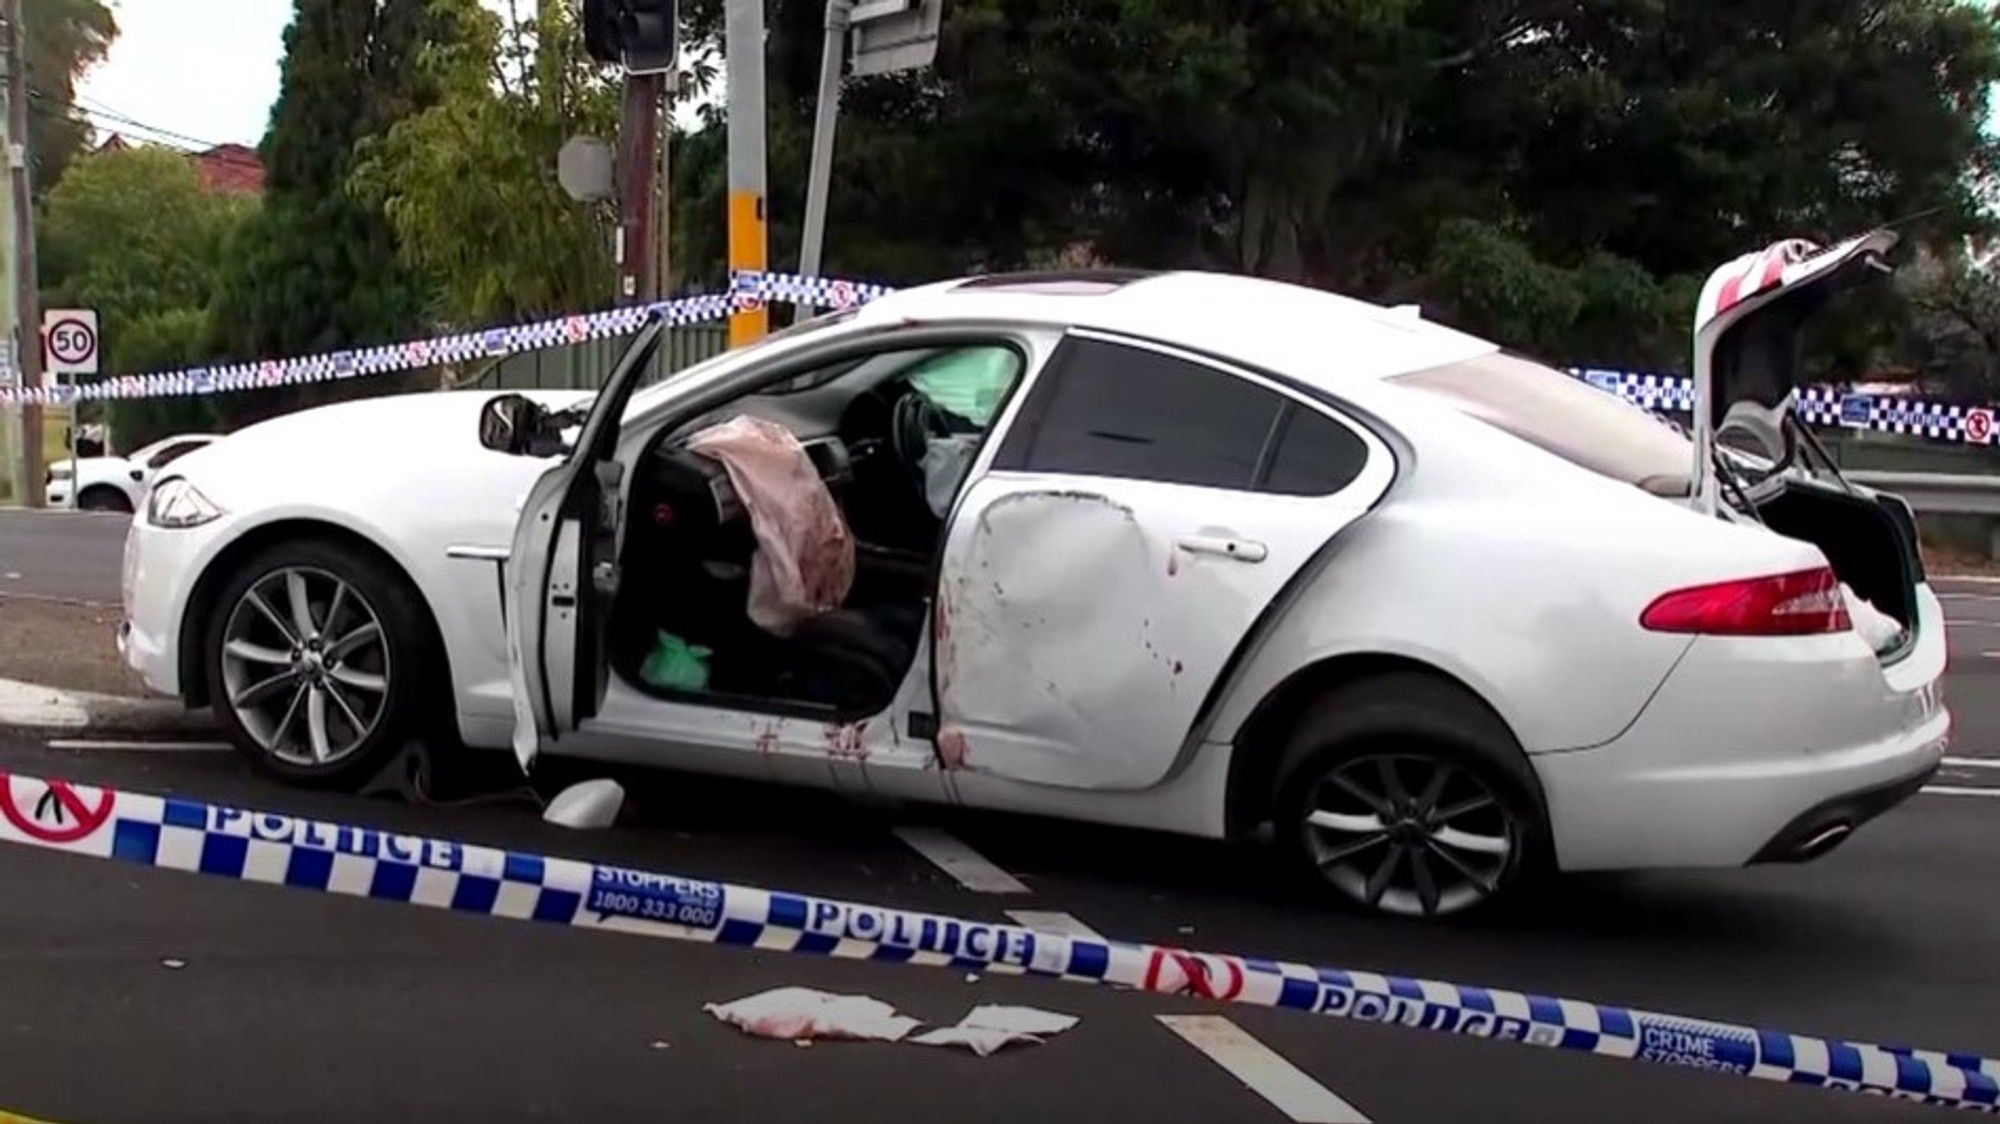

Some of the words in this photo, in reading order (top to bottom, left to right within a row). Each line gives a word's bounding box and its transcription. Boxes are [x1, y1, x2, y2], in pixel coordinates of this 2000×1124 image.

[57, 331, 87, 351] 50
[212, 806, 456, 868] POLICE
[597, 866, 719, 899] STOPPERS
[594, 891, 638, 913] 1800
[642, 898, 677, 920] 333
[679, 905, 715, 925] 000
[813, 902, 1030, 964] POLICE
[1645, 1027, 1715, 1058] CRIME
